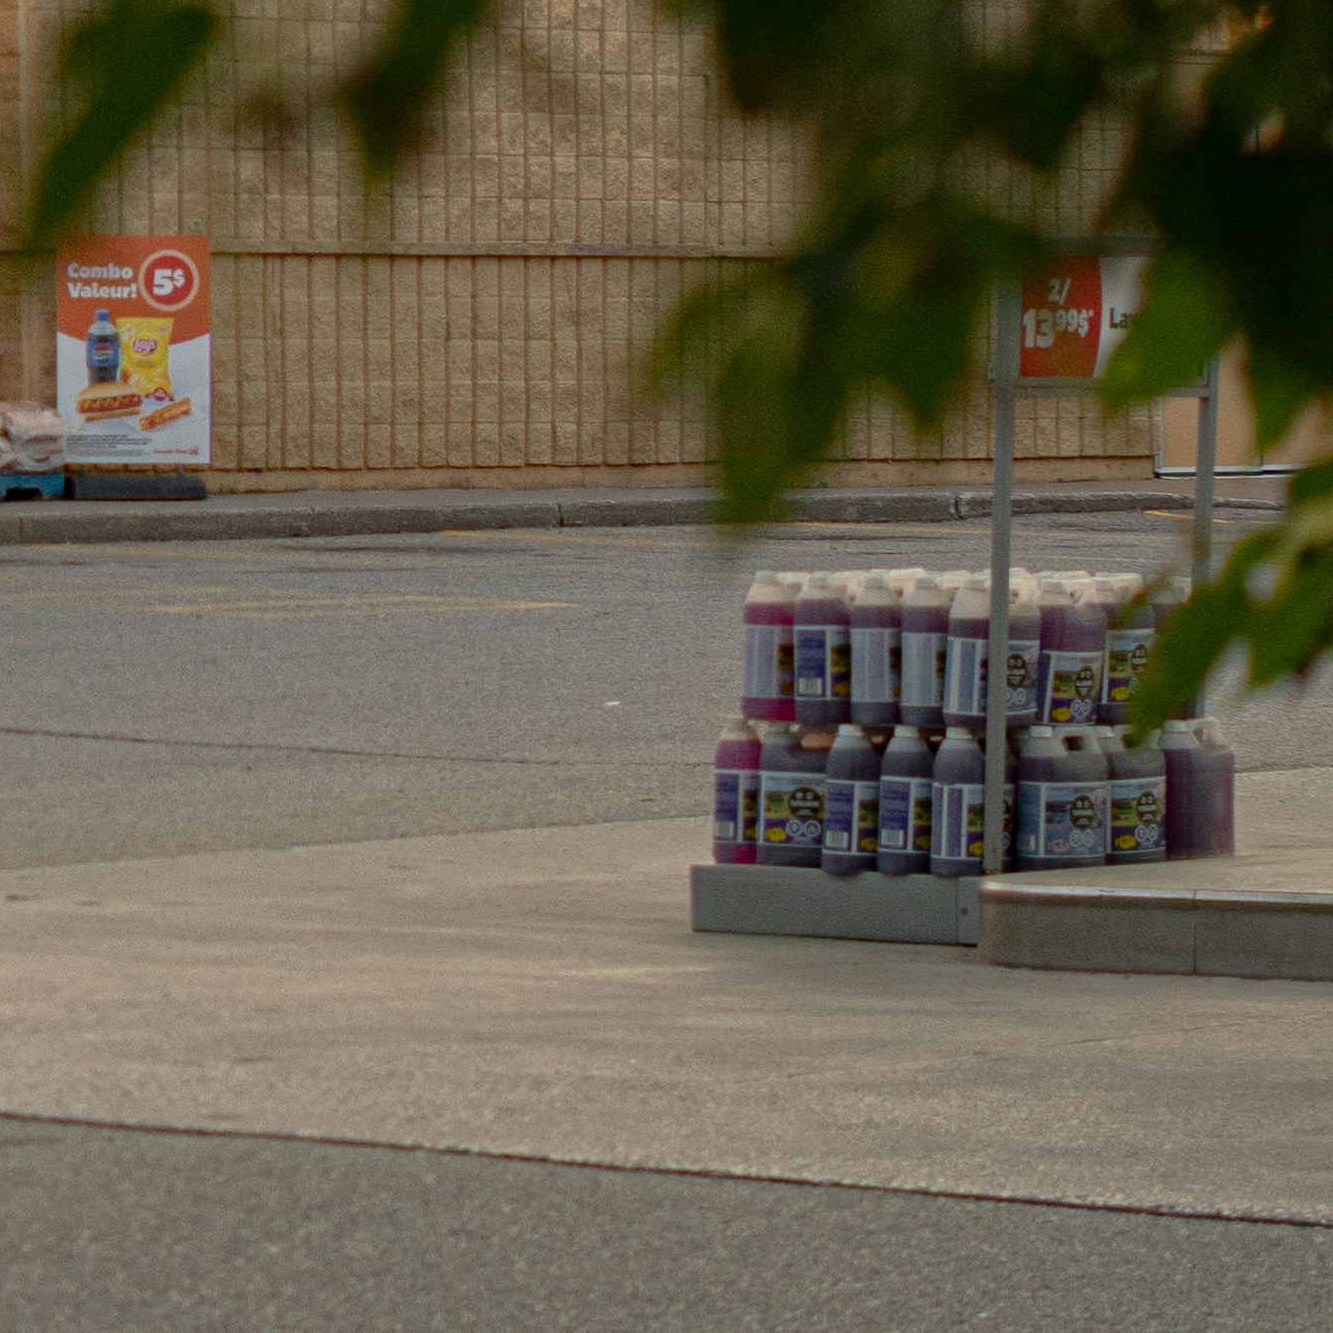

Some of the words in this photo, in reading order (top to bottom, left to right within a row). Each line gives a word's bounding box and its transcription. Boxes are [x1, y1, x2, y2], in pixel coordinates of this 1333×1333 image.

[67, 263, 134, 280] Combo
[67, 281, 138, 299] Valeur!
[152, 268, 185, 296] 5$
